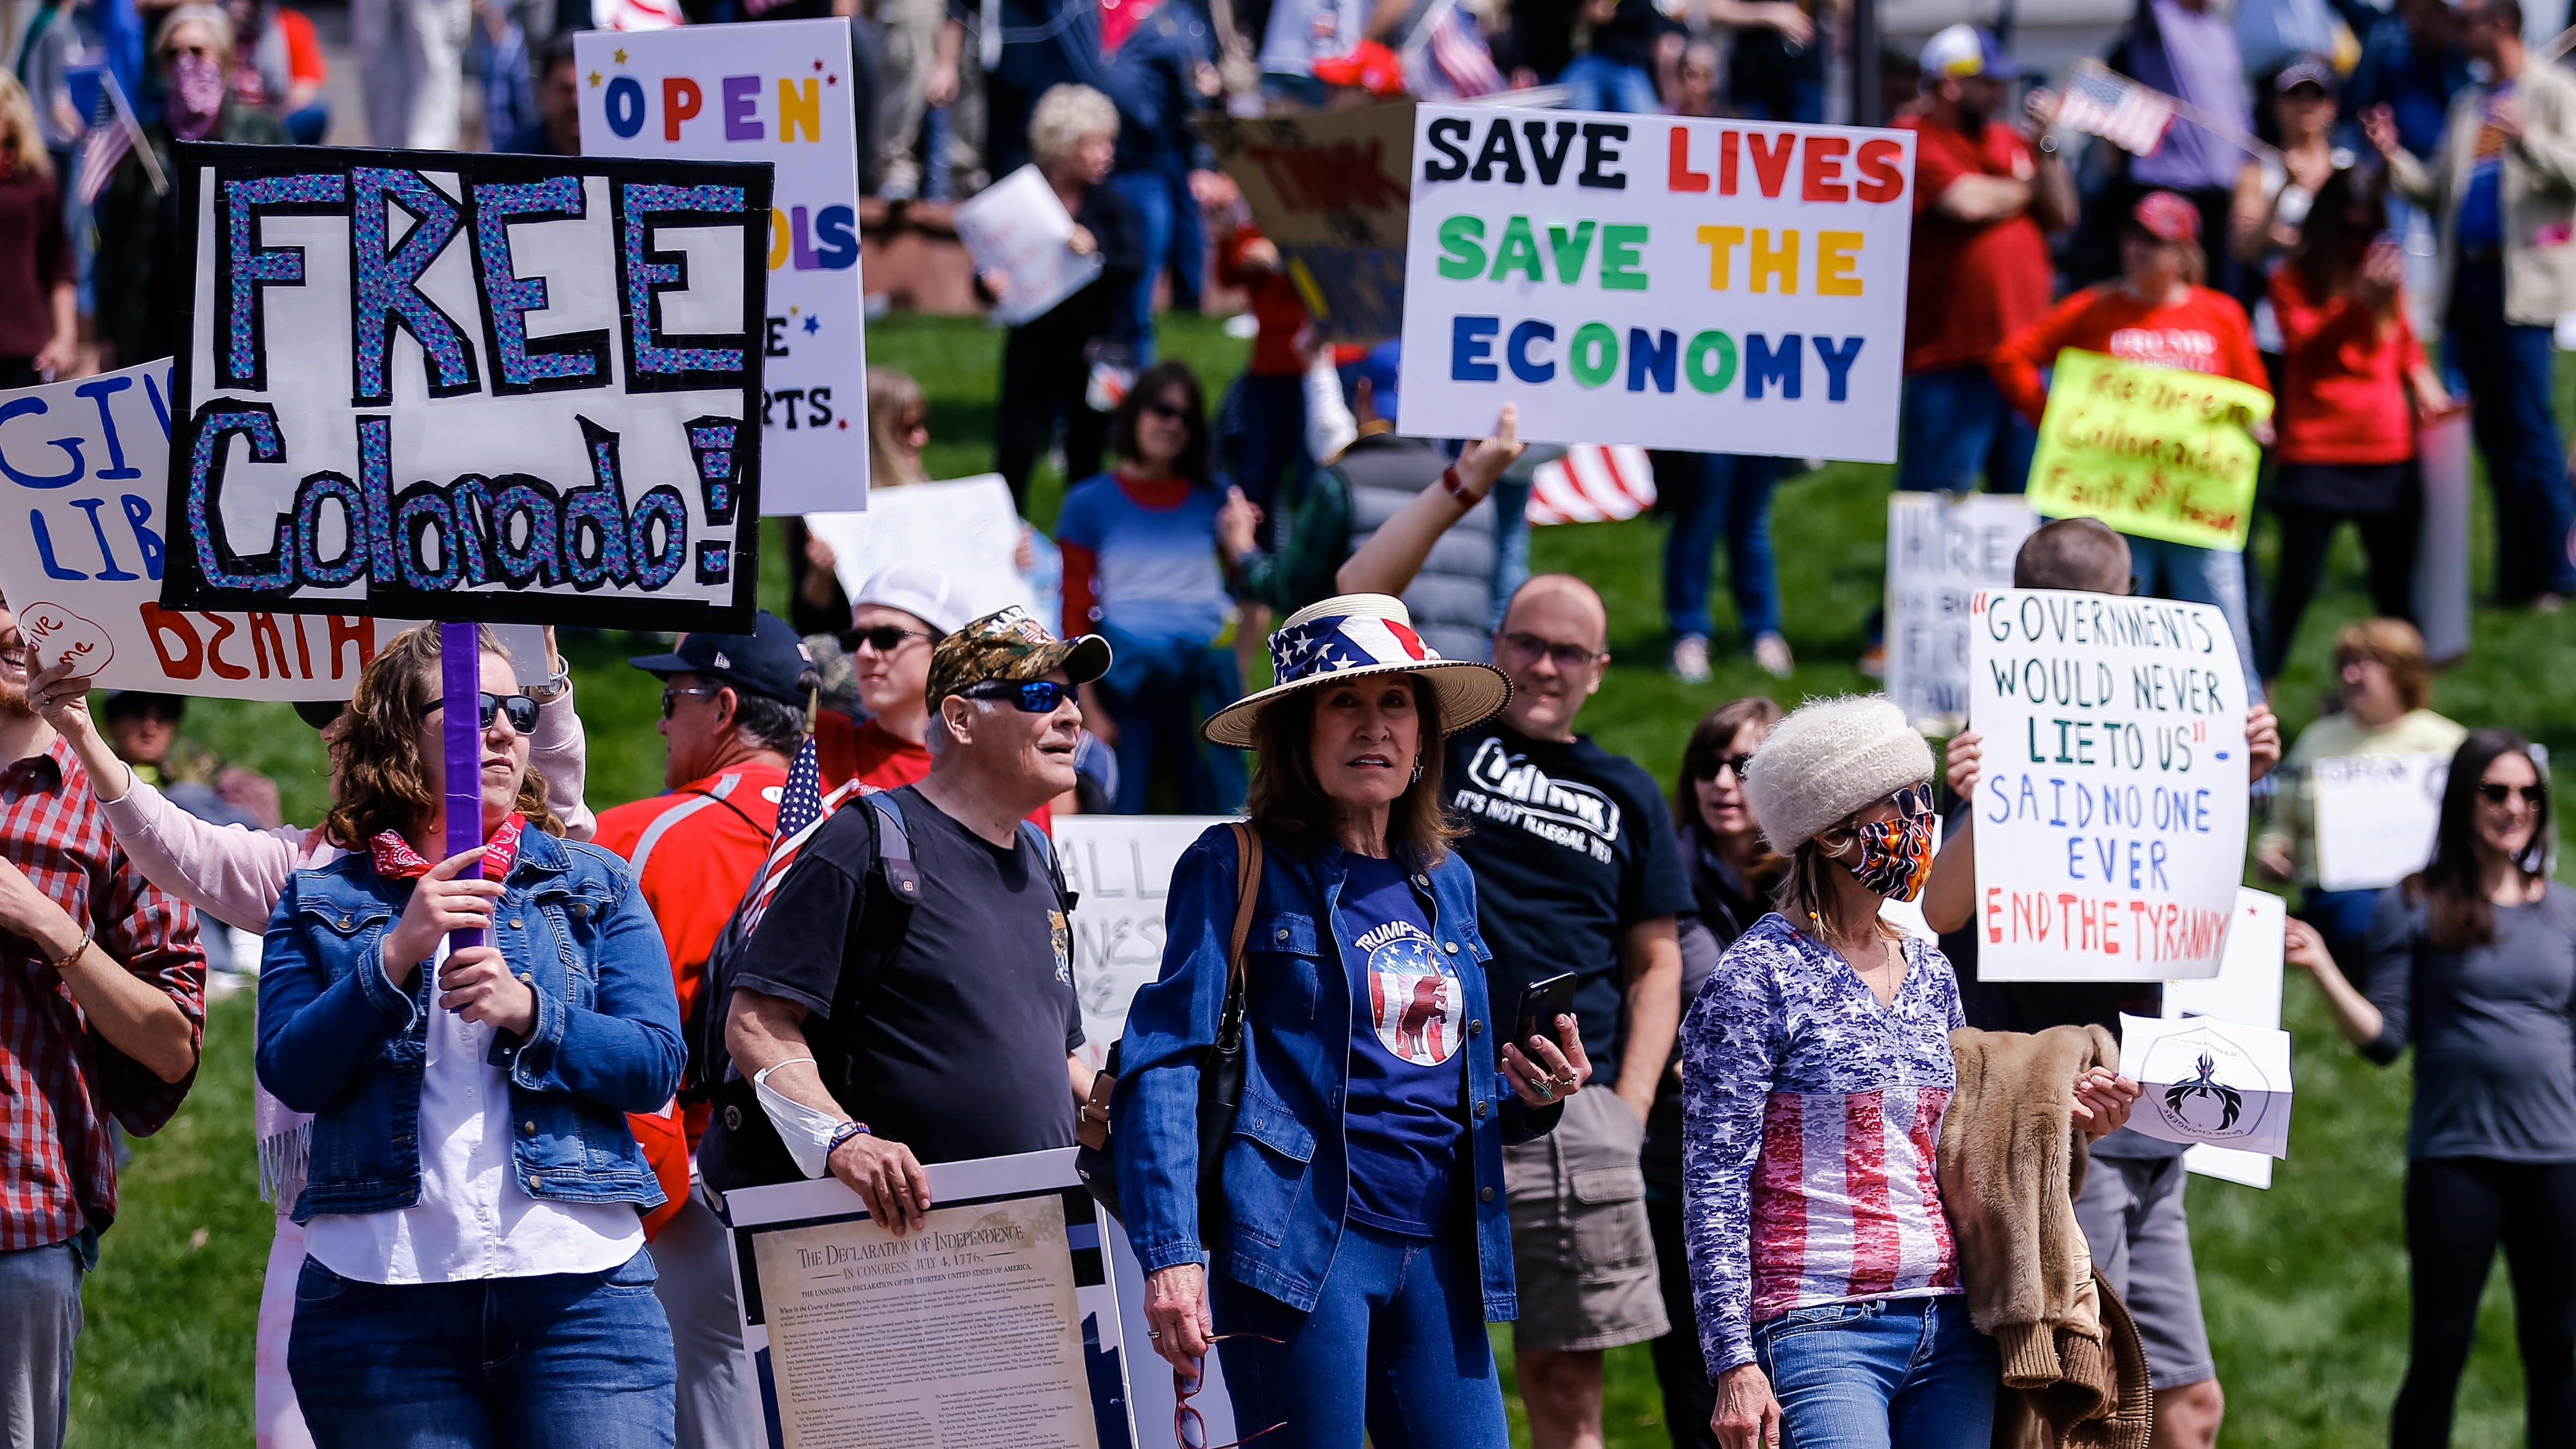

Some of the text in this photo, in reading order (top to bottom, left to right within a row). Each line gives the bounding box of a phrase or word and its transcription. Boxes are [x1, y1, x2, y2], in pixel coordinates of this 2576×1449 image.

[605, 75, 821, 143] OPEN
[1425, 117, 1904, 204] SAVE LIVES
[1438, 213, 1650, 291] SAVE
[1696, 224, 1865, 297] THE
[216, 168, 751, 406] FREE
[1451, 315, 1863, 402] ECONOMY
[186, 397, 744, 593] Colorado!
[1989, 658, 2224, 715] WOULD NEVER
[1454, 789, 1487, 813] IT'S
[1485, 798, 1521, 826] NOT
[1988, 774, 2212, 833] SAID NO ONE
[2069, 837, 2171, 892] EVER
[1987, 886, 2050, 944] END
[2058, 893, 2119, 955] THE
[797, 1225, 1024, 1268] THE DECLARATION OF INDEPENDENCE
[843, 1251, 984, 1279] IN CONGRESS, JULY 4, 1776.
[801, 1290, 814, 1298] THE
[814, 1286, 851, 1296] UNANIMOUS
[852, 1280, 893, 1292] DECLARATION
[916, 1274, 946, 1284] THIRTEEN
[947, 1271, 972, 1280] UNITED
[972, 1268, 993, 1277] STATES
